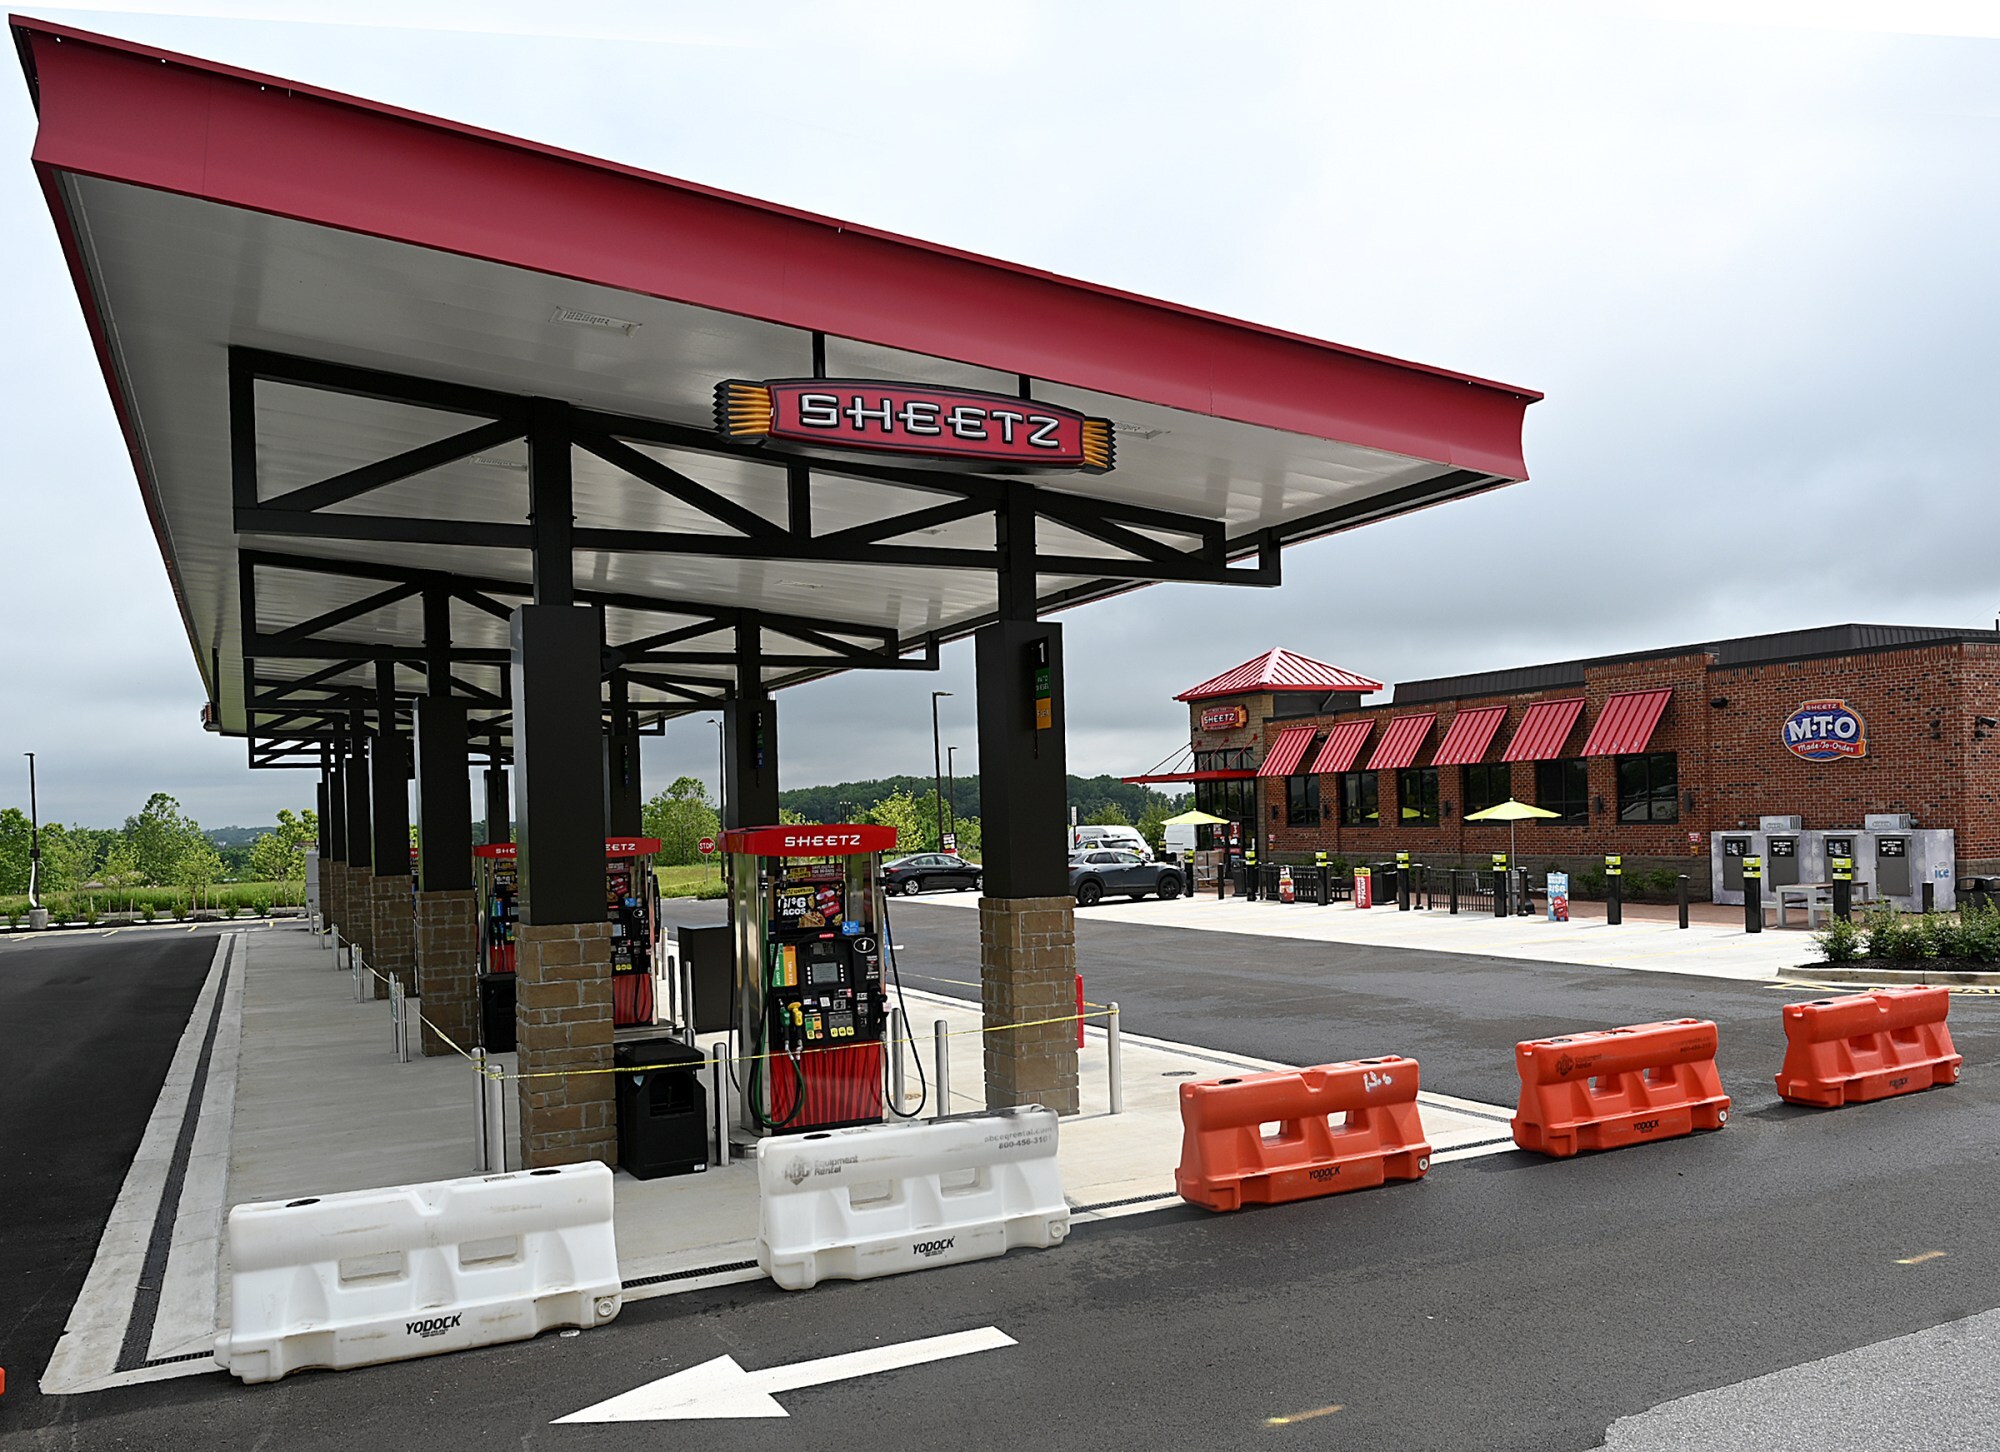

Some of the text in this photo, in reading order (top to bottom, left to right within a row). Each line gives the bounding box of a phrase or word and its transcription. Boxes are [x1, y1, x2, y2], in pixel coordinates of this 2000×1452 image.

[800, 393, 1060, 447] SHEETZ
[1039, 642, 1045, 663] 1
[1204, 713, 1235, 724] SHEETZ
[699, 842, 714, 850] STOP
[785, 835, 861, 847] SHEETZ
[1935, 865, 1949, 879] ice
[778, 908, 806, 916] ACOS
[861, 940, 867, 950] 1
[1633, 1120, 1659, 1131] YODOCK
[814, 1156, 858, 1168] Equipment
[814, 1166, 842, 1176] Rental
[1309, 1166, 1341, 1180] YODOCK
[913, 1237, 955, 1254] YODOCK
[406, 1314, 462, 1335] YODOCK
